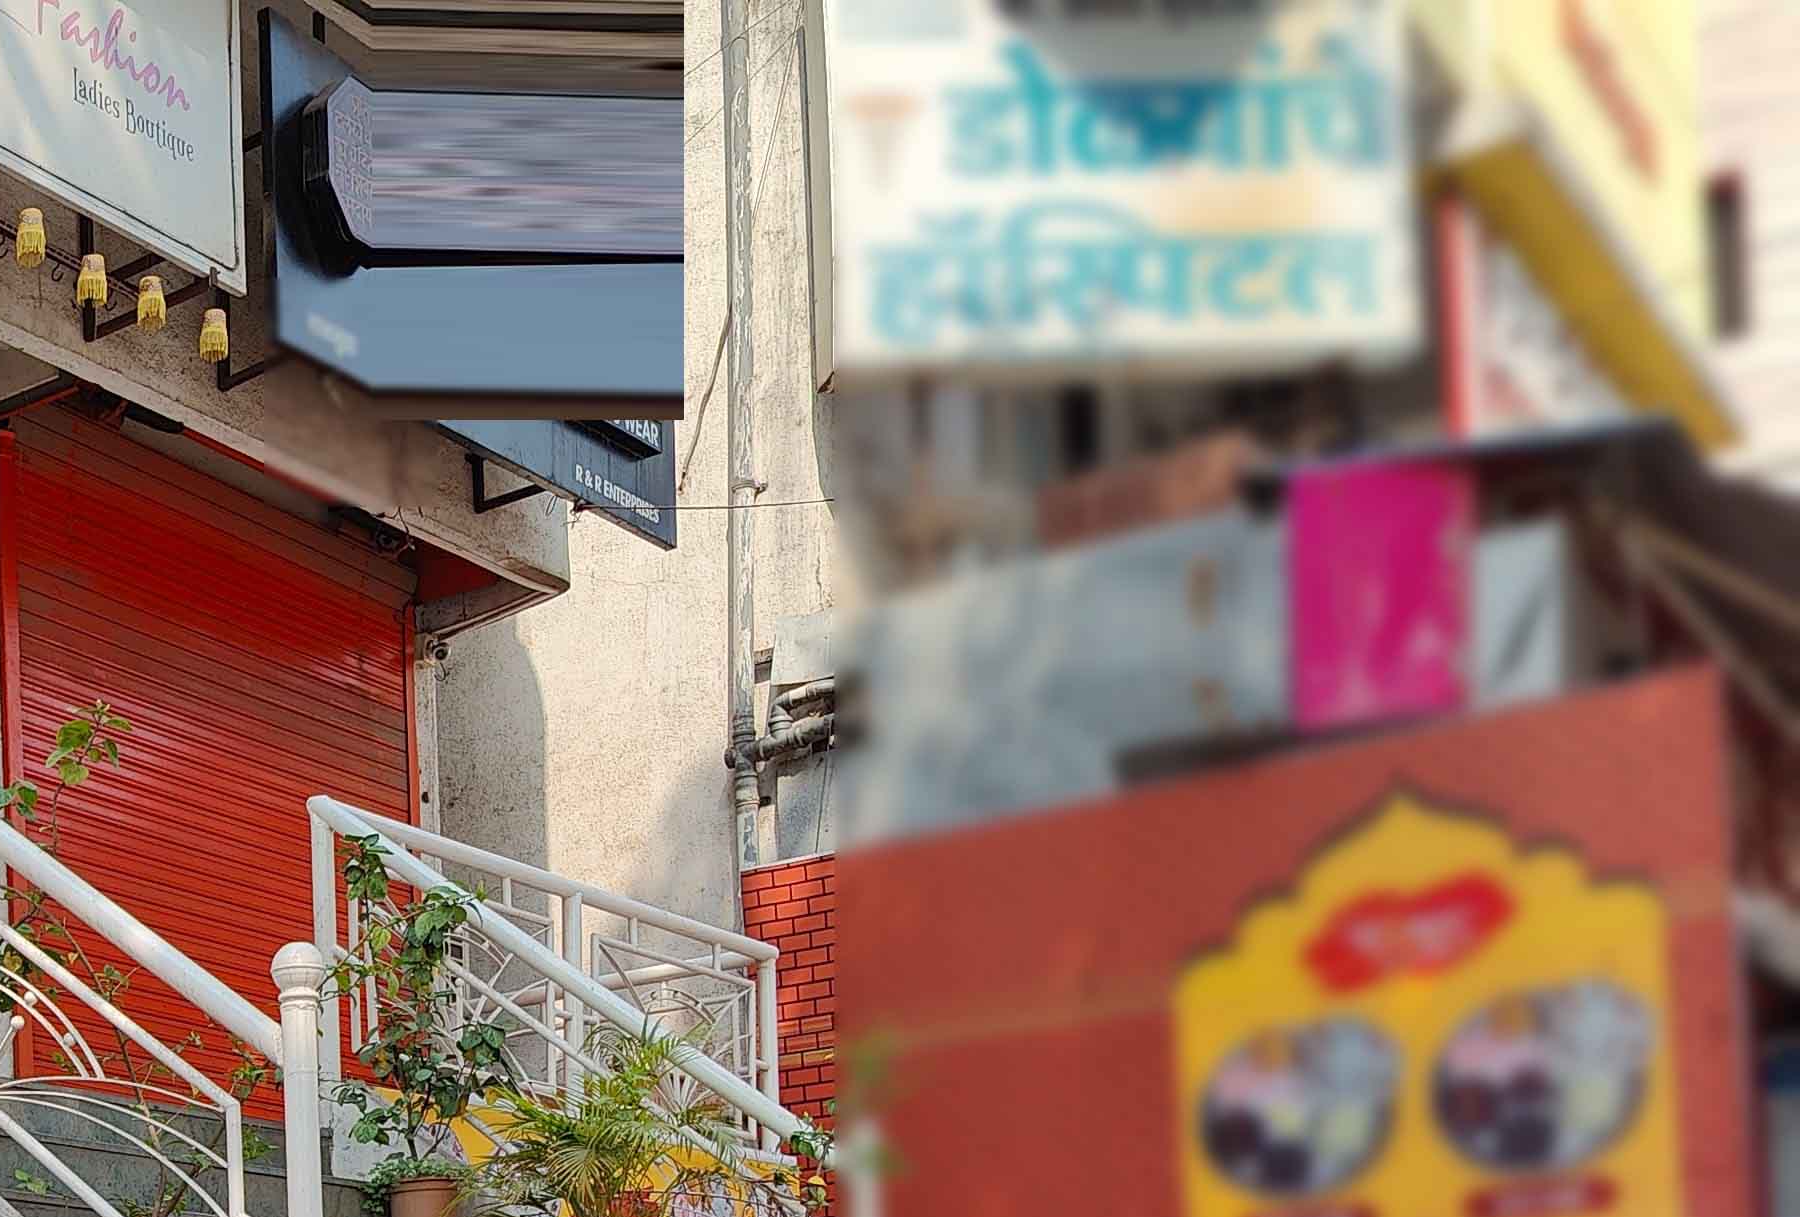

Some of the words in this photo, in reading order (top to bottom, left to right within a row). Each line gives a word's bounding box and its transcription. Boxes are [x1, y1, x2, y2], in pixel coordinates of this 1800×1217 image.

[73, 66, 120, 119] Ladies
[124, 97, 195, 162] Boutique
[575, 463, 583, 484] R
[584, 469, 594, 489] &
[594, 474, 603, 494] R
[603, 479, 660, 524] ENTERPRISES
